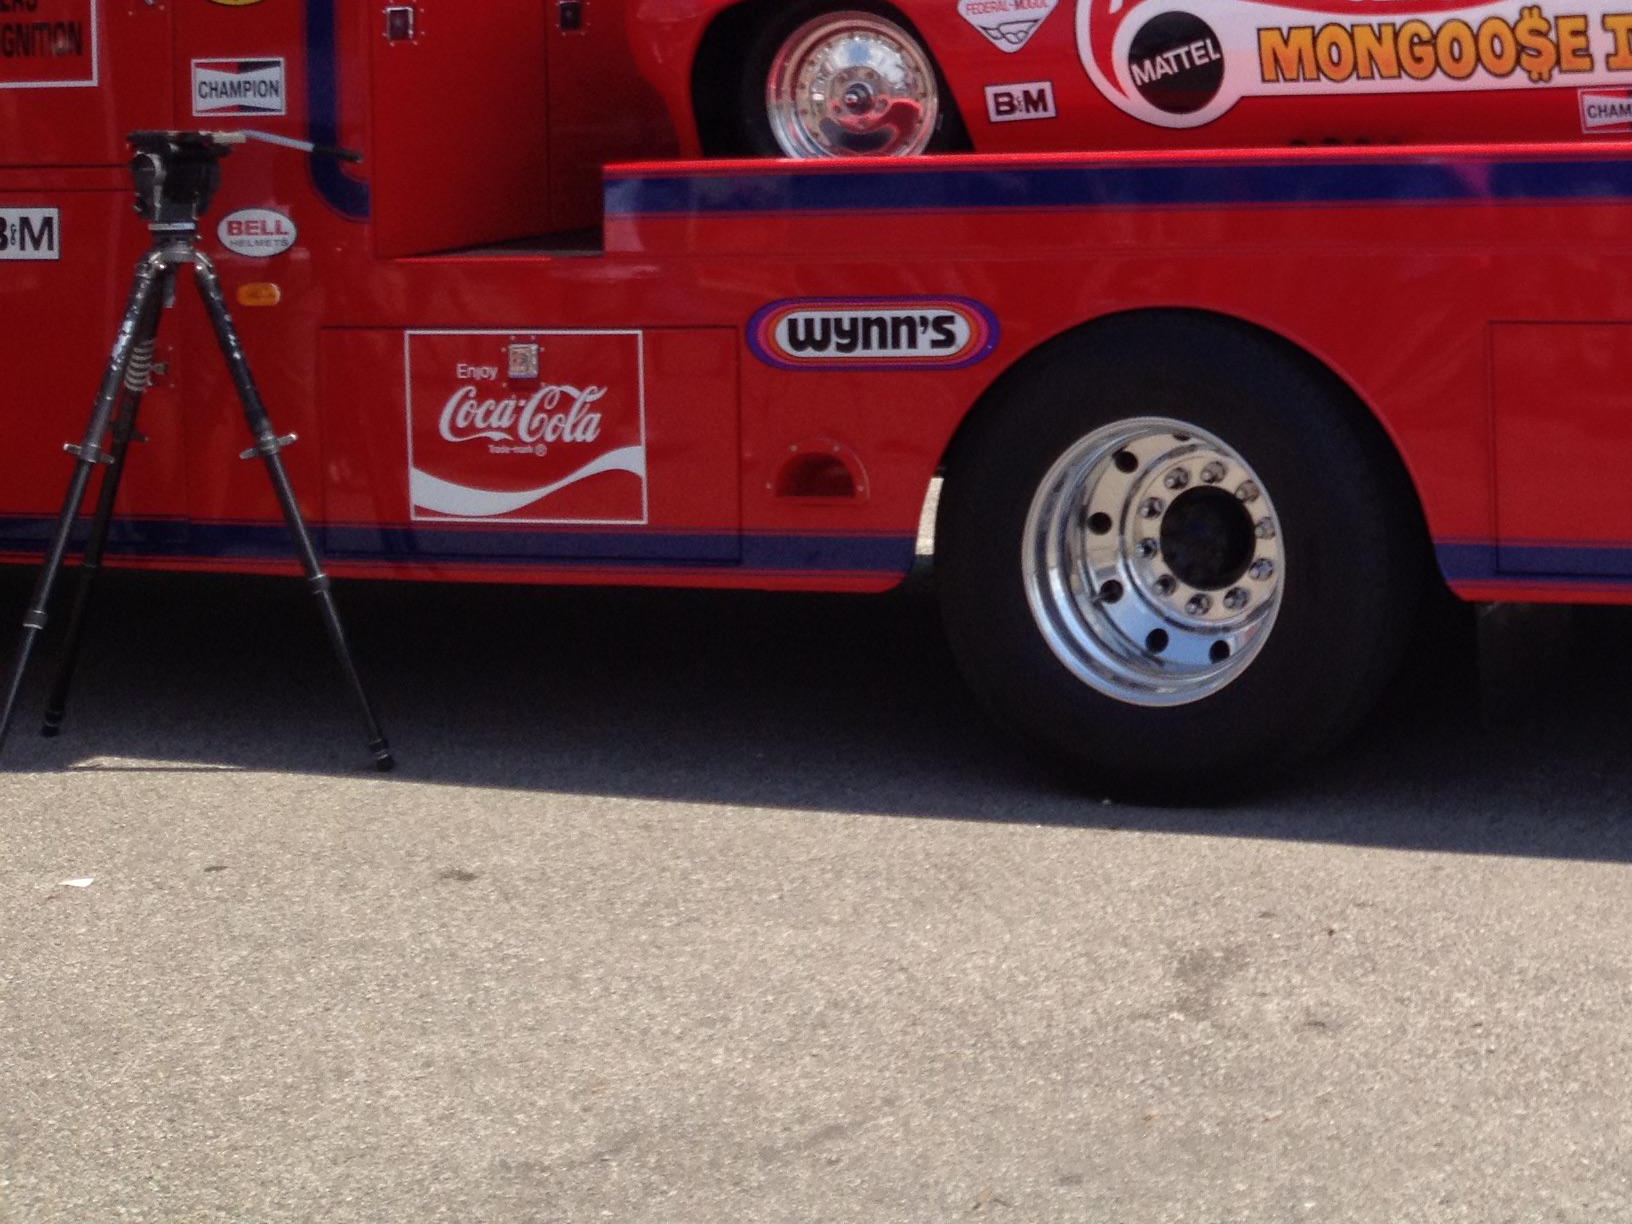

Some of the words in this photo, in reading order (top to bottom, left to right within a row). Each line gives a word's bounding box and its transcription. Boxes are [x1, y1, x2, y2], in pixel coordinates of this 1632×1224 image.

[1131, 37, 1223, 87] MATTEL
[197, 79, 280, 100] CHAMPION
[993, 88, 1049, 117] B&M
[226, 219, 289, 236] BELL
[229, 237, 289, 247] HELMETS
[456, 363, 498, 381] Enjoy
[438, 385, 608, 443] Coca-Cola
